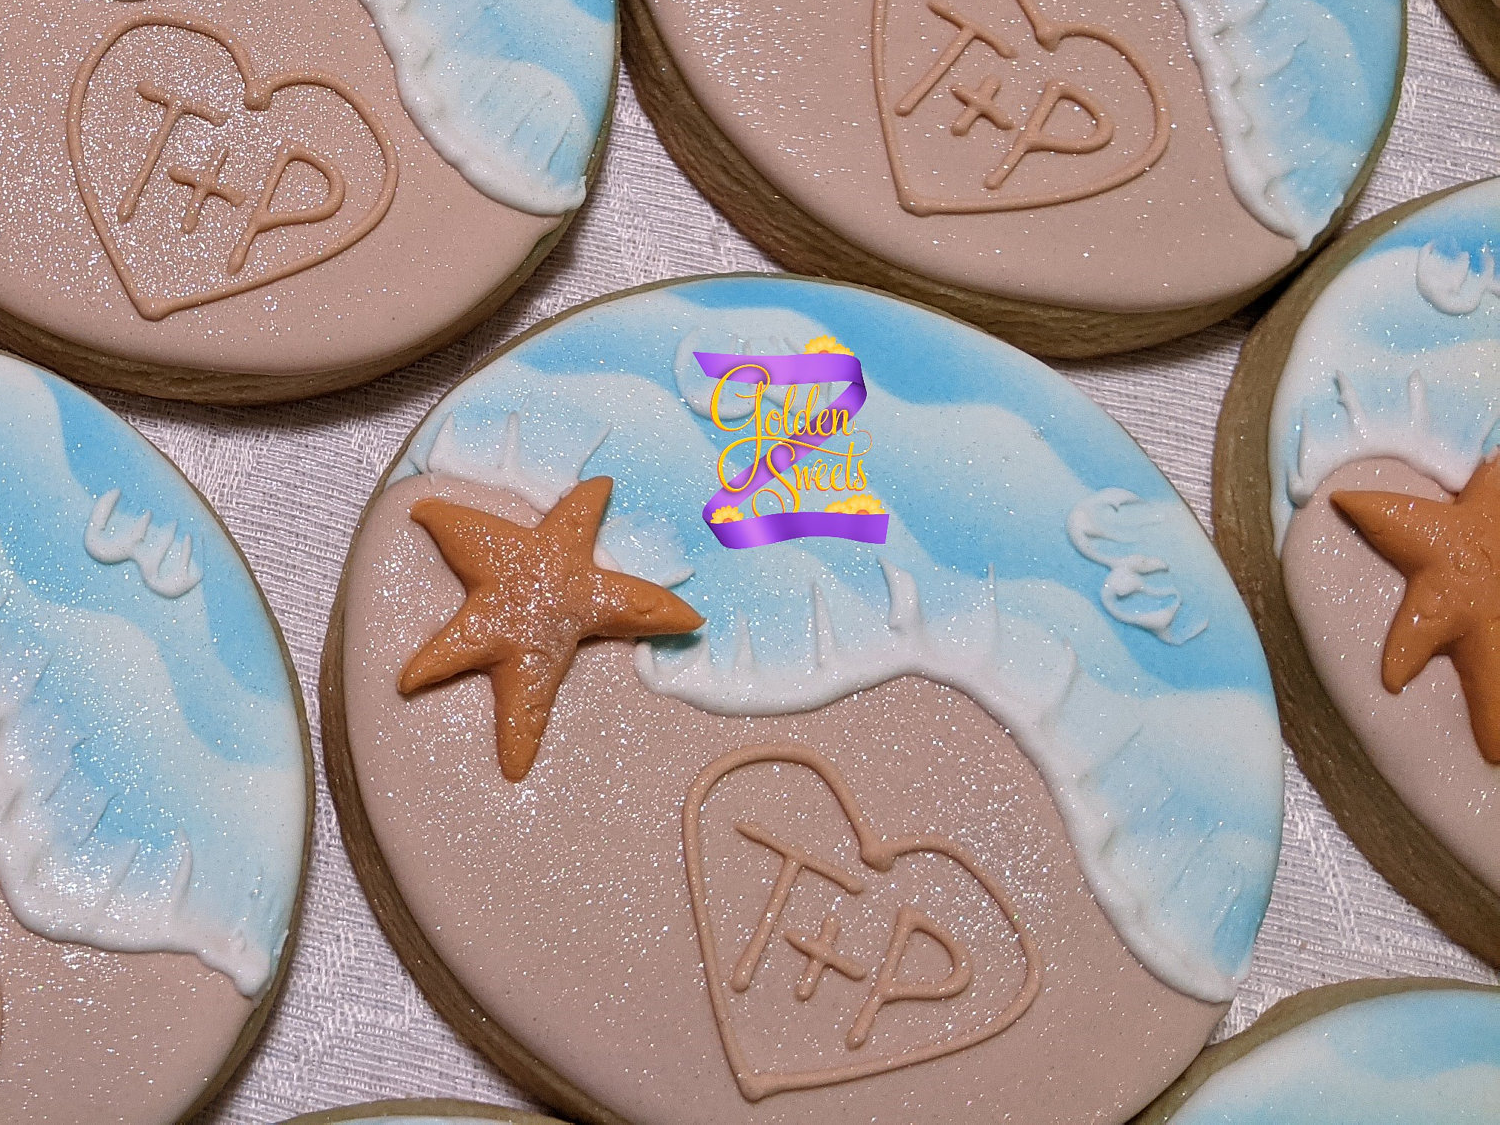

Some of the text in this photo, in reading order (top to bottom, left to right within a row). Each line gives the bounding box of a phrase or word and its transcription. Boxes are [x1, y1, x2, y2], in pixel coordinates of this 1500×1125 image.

[117, 81, 345, 275] T+P
[895, 0, 1114, 190] T+P
[730, 822, 973, 1049] T+P
